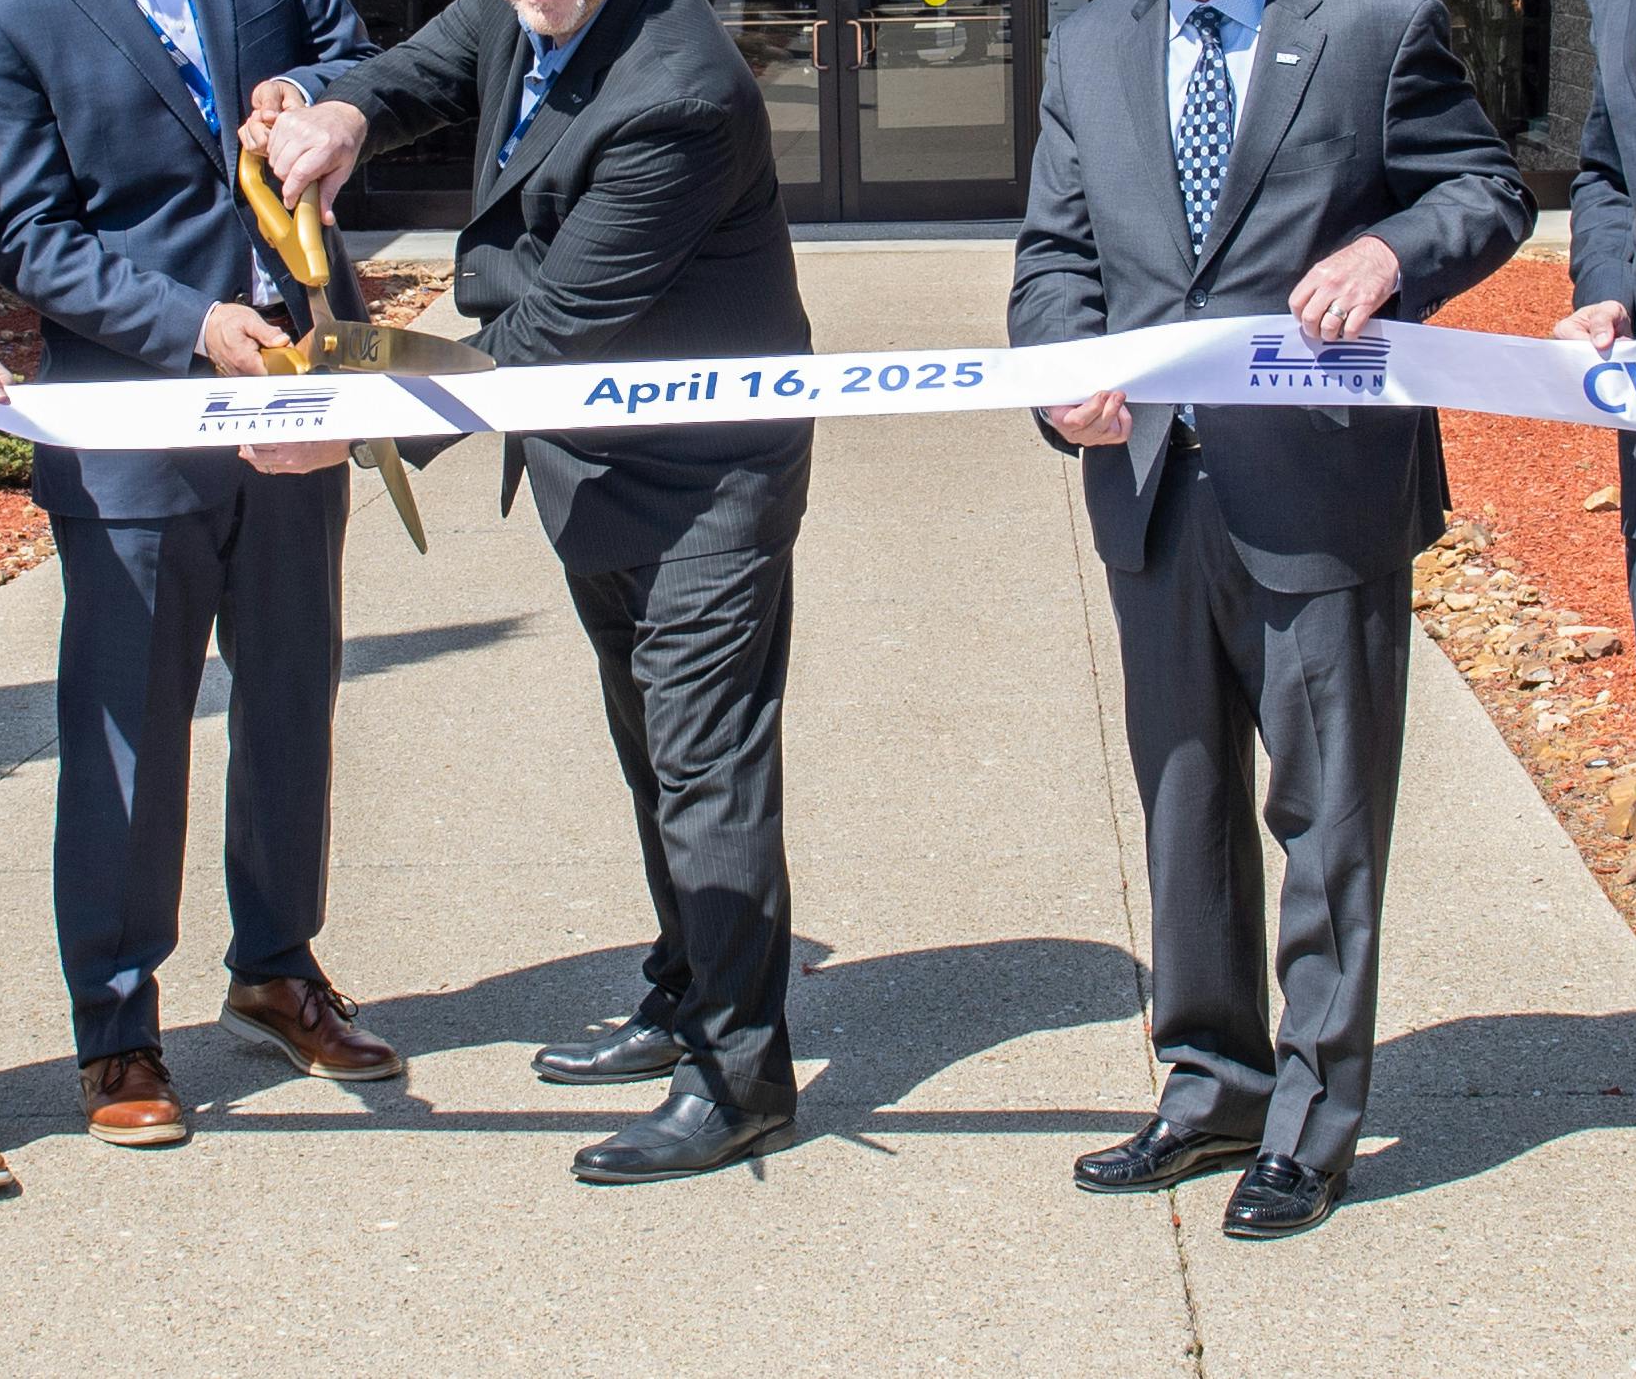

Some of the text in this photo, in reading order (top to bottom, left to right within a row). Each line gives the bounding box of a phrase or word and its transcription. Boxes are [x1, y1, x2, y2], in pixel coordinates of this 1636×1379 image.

[349, 328, 380, 362] CVG
[583, 361, 984, 414] April 16, 2025
[1249, 373, 1384, 389] AVIATION
[198, 416, 325, 432] AVIATION
